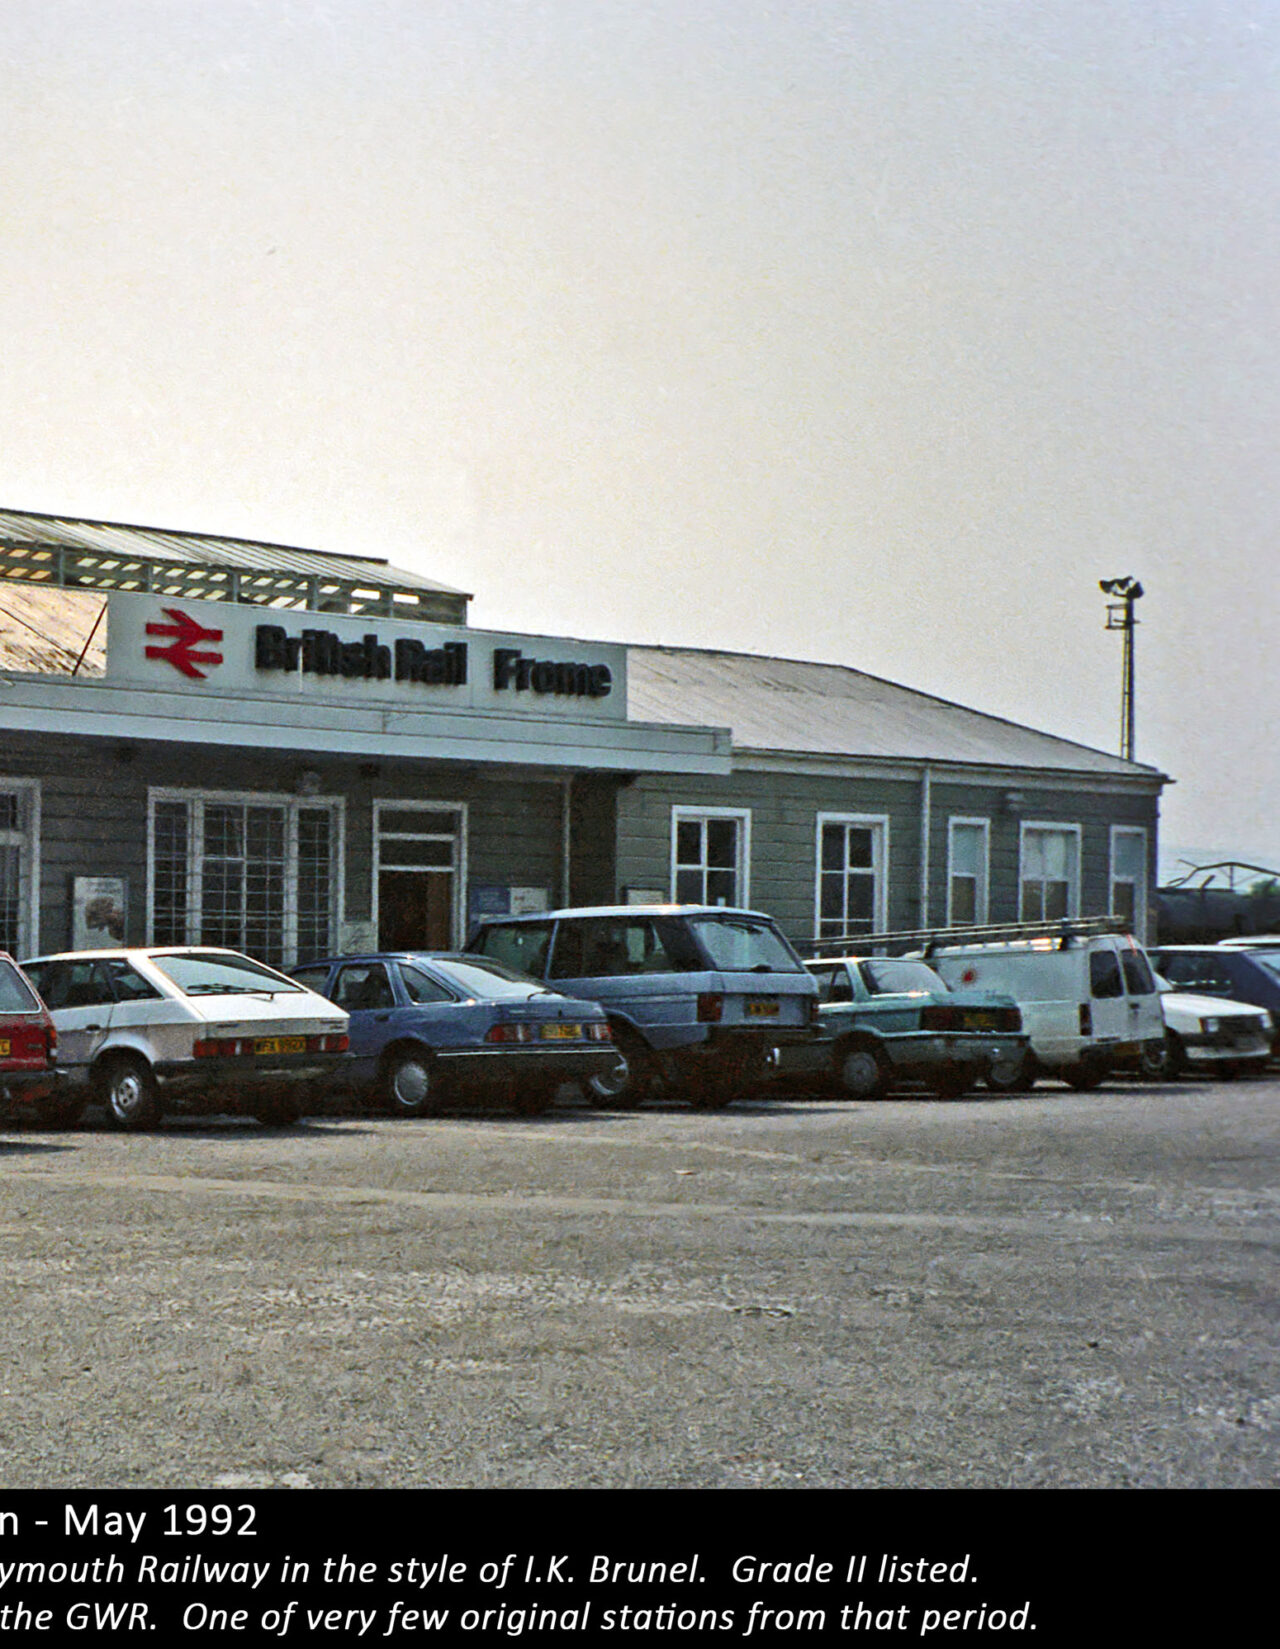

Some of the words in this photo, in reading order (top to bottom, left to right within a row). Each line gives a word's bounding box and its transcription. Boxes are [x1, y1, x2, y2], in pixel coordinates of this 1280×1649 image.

[255, 624, 390, 679] British
[394, 638, 468, 686] Rail
[493, 648, 613, 697] Frome
